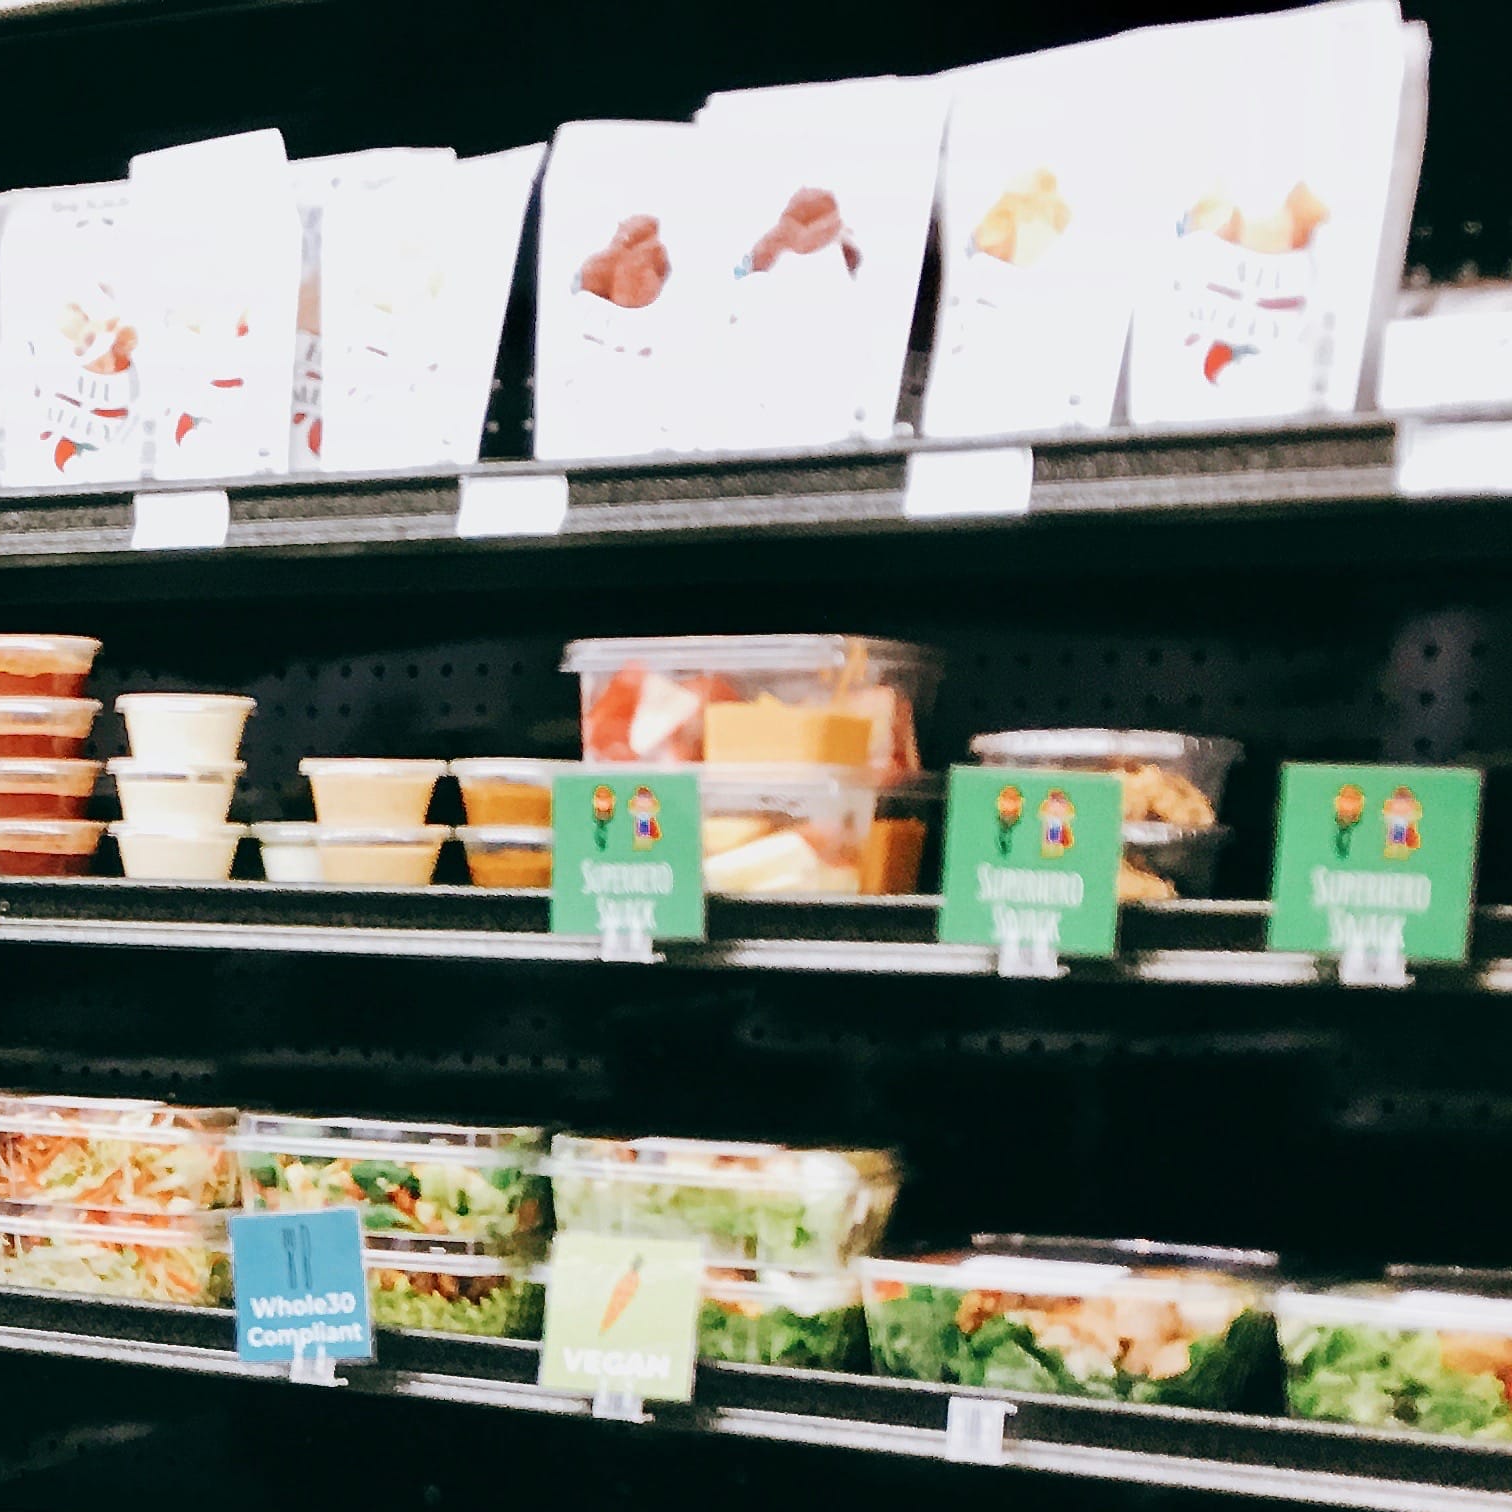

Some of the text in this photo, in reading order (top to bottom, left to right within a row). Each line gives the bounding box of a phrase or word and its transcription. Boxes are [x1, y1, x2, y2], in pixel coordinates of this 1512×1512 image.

[250, 1291, 356, 1319] Whole30
[247, 1321, 364, 1348] Compliant
[563, 1347, 671, 1379] VEGAN
